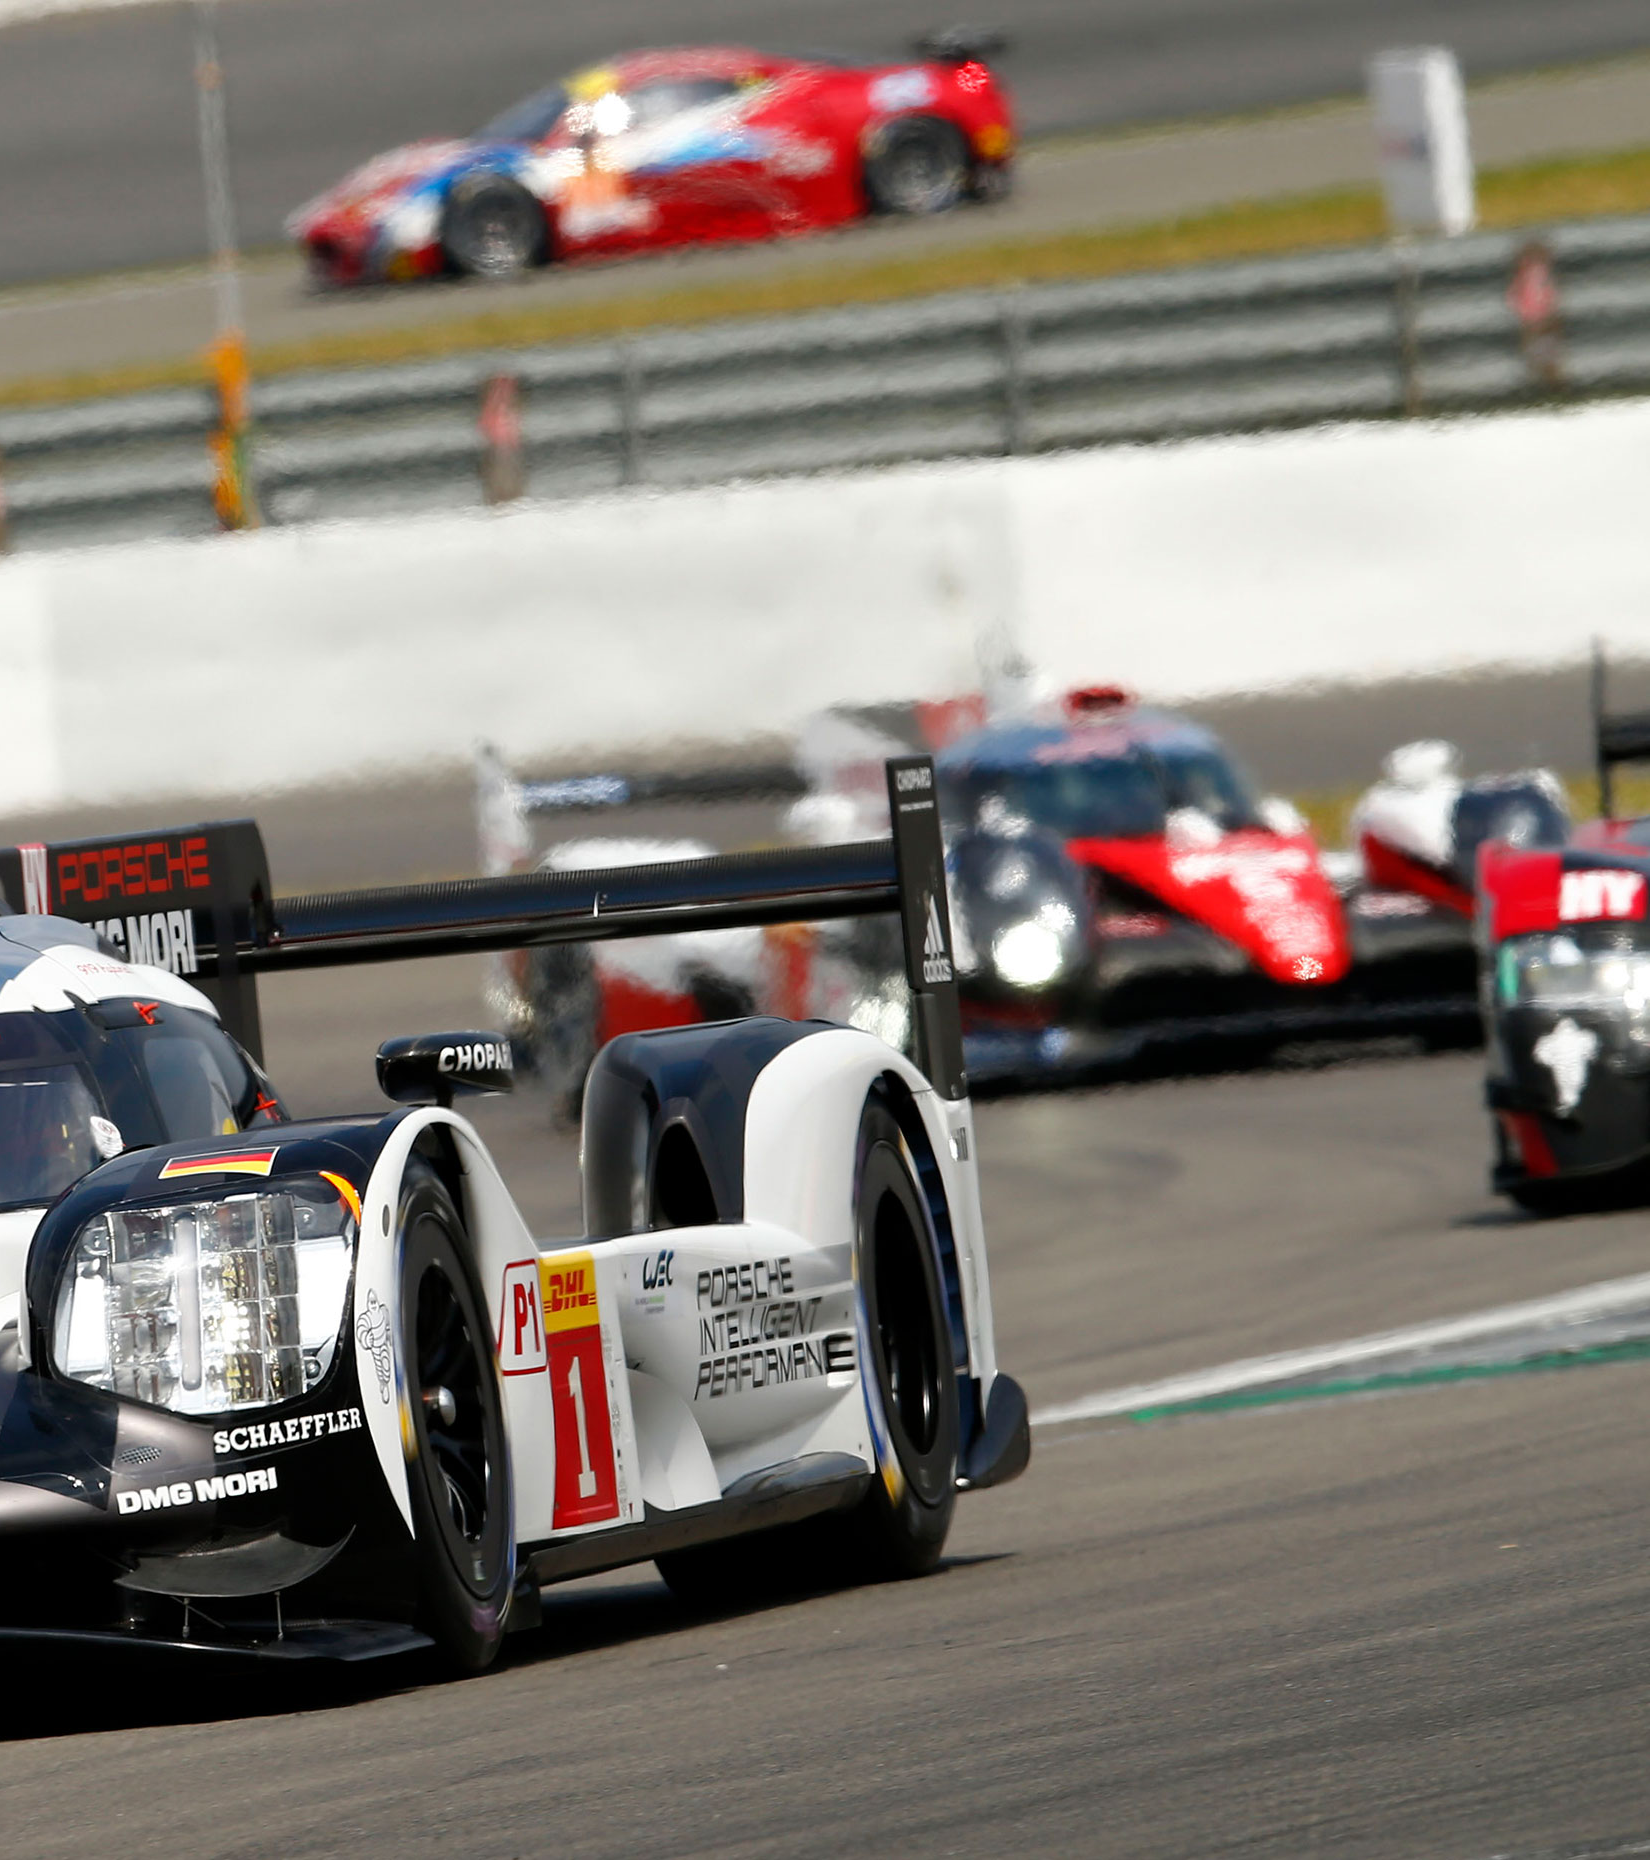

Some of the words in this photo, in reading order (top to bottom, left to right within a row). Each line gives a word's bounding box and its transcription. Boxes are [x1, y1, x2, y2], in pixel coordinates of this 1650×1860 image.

[58, 837, 210, 905] PORSCHE
[1558, 869, 1646, 921] HY
[126, 908, 198, 975] MORI
[547, 1269, 592, 1313] DHL
[642, 1249, 674, 1290] WEC
[696, 1257, 794, 1312] PORSCHE
[513, 1280, 541, 1356] P1
[699, 1296, 823, 1356] INTELLIGENT
[213, 1407, 363, 1455] SCHAEFFLER
[567, 1355, 597, 1499] 1
[116, 1482, 194, 1515] DMG
[194, 1467, 278, 1502] MORI
